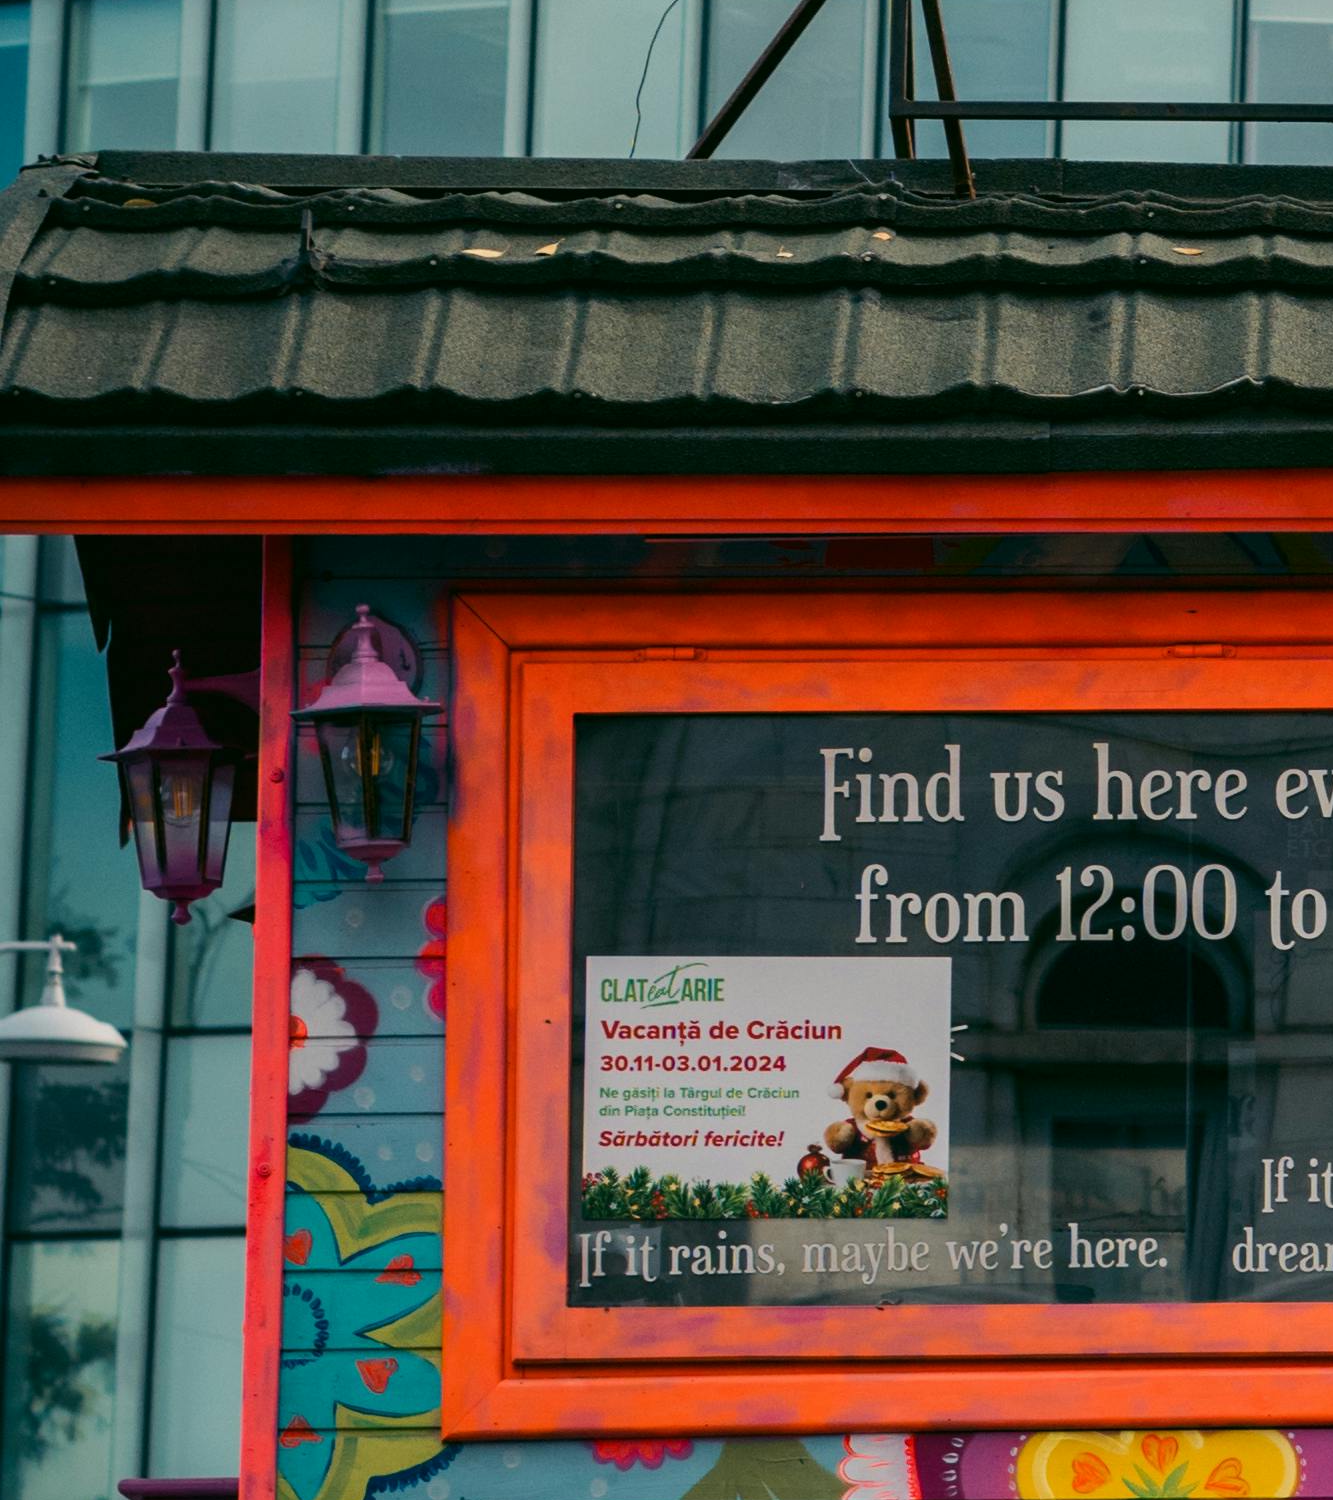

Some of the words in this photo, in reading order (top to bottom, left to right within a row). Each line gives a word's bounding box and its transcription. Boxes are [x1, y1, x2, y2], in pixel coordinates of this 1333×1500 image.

[820, 745, 964, 840] Find
[990, 771, 1064, 821] us
[1093, 743, 1247, 820] here
[855, 864, 1029, 943] from
[1056, 864, 1236, 940] 12:00
[1265, 871, 1327, 950] to
[601, 1020, 700, 1046] Vacanță
[709, 1021, 739, 1039] de
[747, 1020, 841, 1039] Crăciun
[600, 1056, 786, 1071] 30.11-03.01.2024
[600, 1087, 619, 1098] Ne
[664, 1088, 675, 1098] la
[680, 1087, 722, 1101] Târgul
[726, 1088, 743, 1098] de
[747, 1087, 799, 1099] Crăciun
[599, 1105, 620, 1116] din
[598, 1130, 699, 1147] Sărbători
[704, 1130, 784, 1147] fericite!
[1262, 1156, 1294, 1213] If
[579, 1231, 611, 1287] If
[625, 1235, 656, 1281] it
[668, 1231, 784, 1276] rains,
[801, 1227, 930, 1284] maybe
[946, 1223, 1053, 1271] we're
[1068, 1223, 1168, 1270] here.
